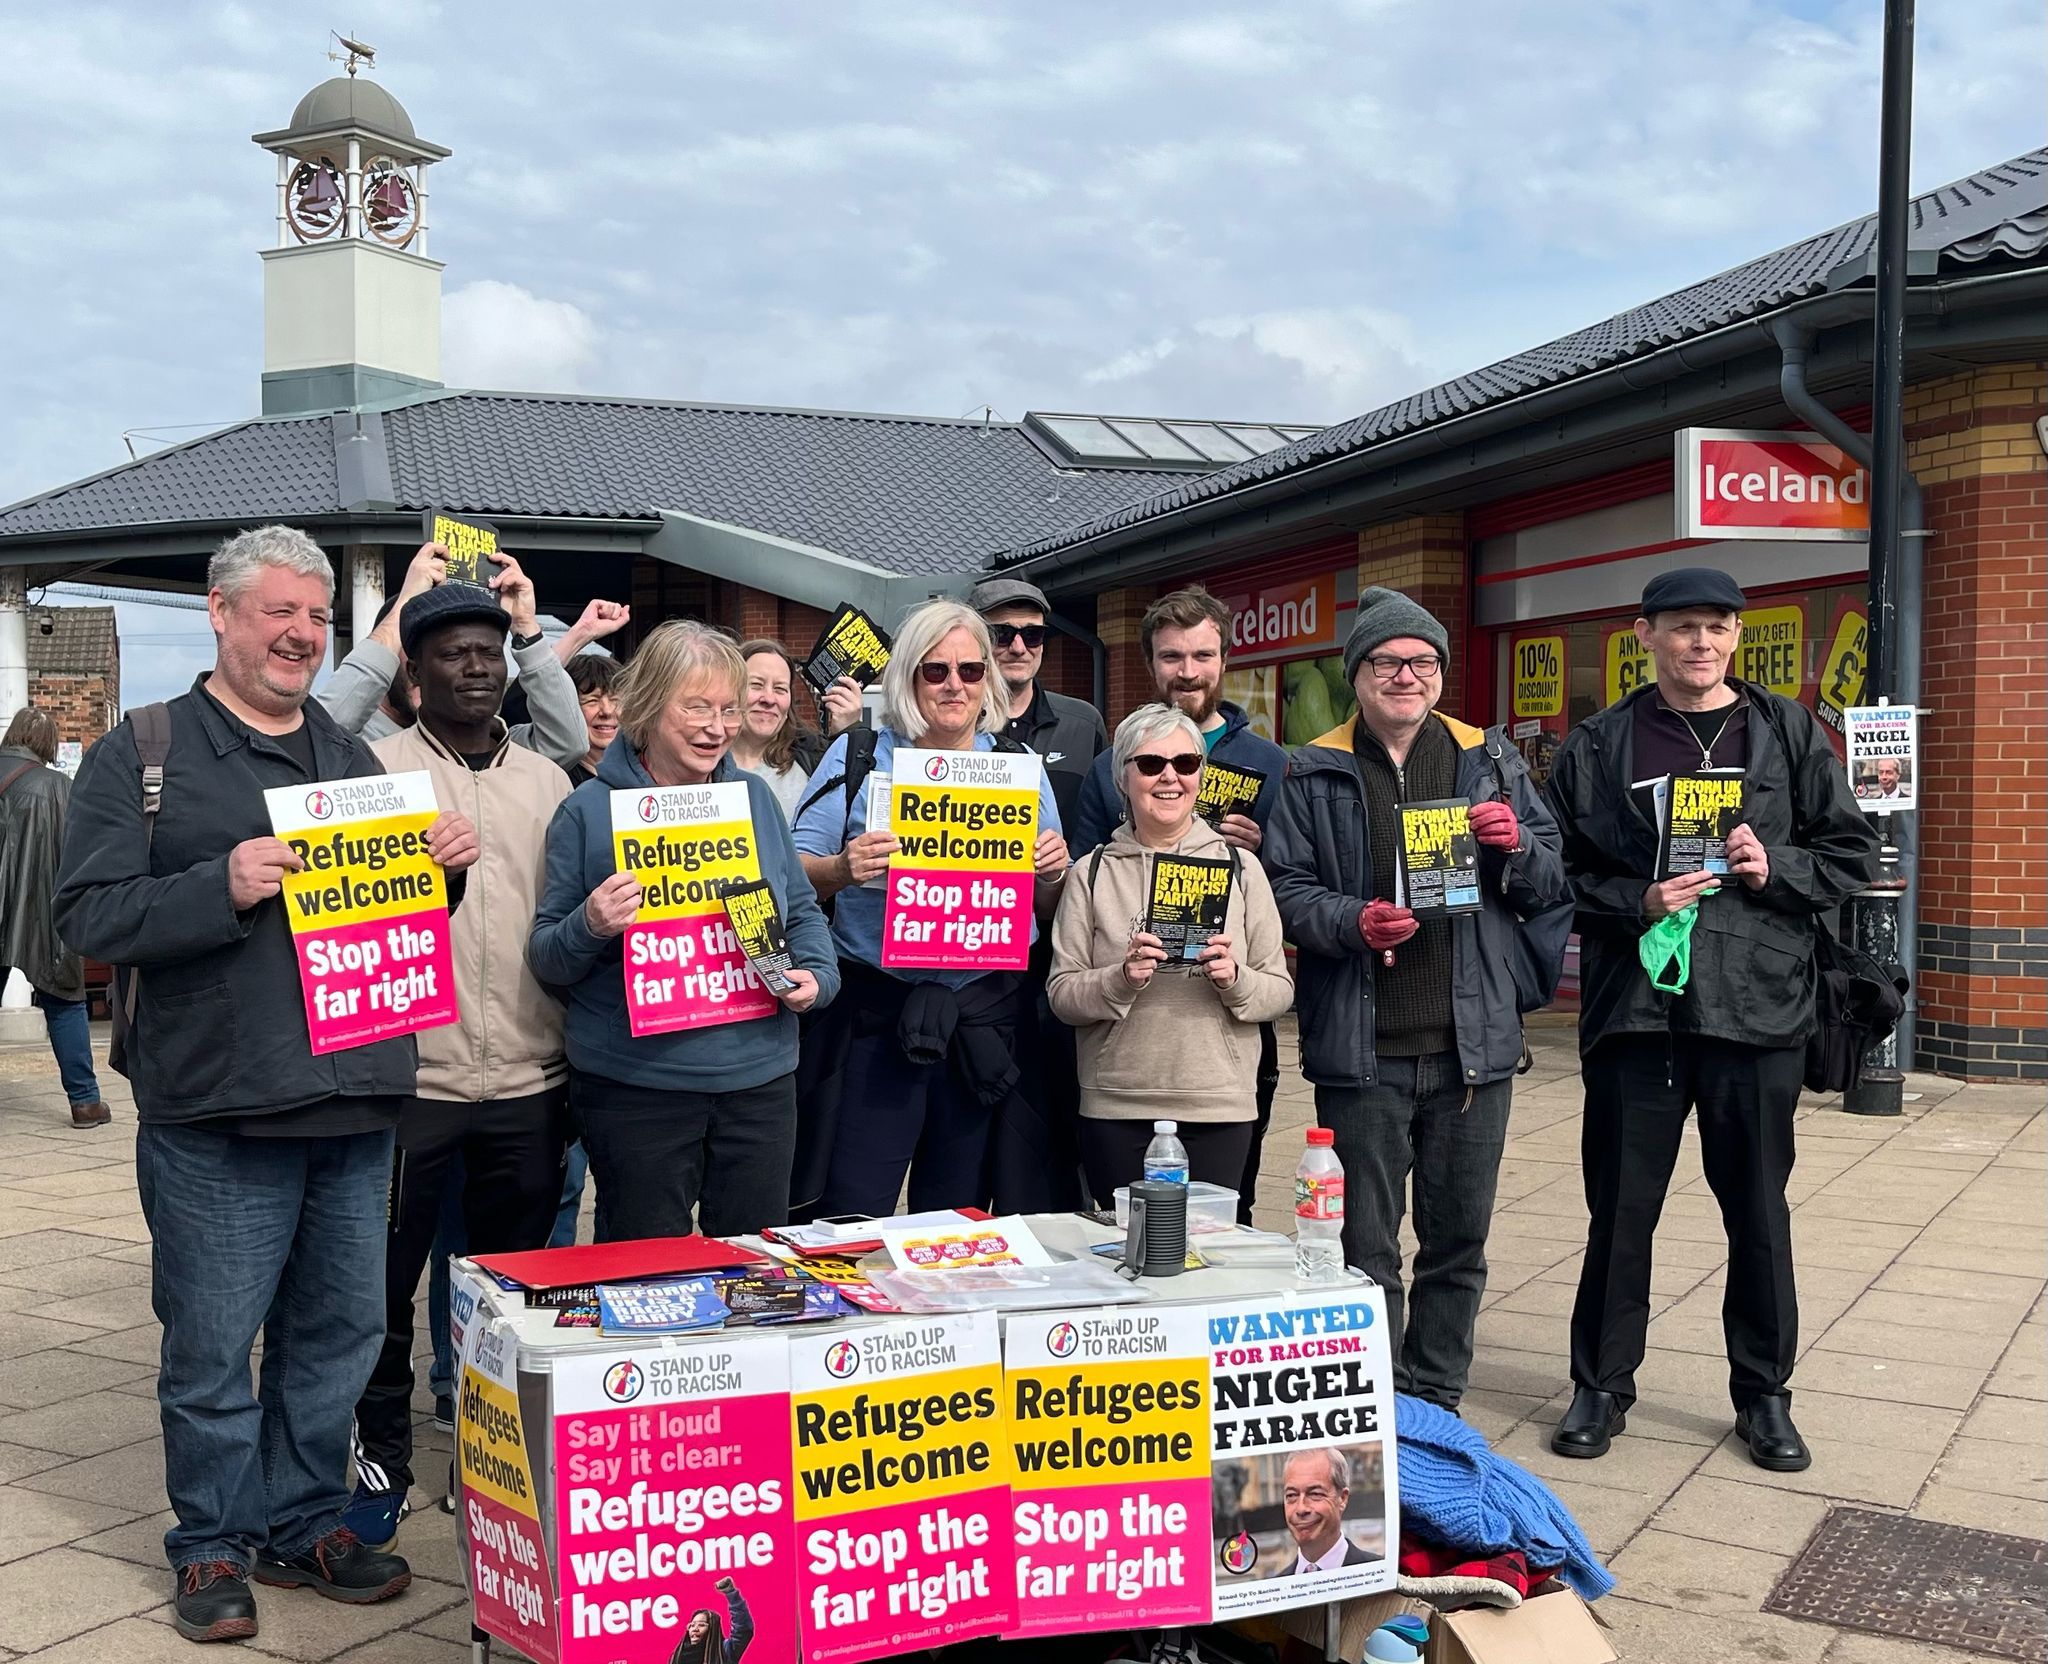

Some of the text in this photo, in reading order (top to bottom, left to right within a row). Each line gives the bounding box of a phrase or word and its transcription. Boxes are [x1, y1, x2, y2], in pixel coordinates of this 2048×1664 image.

[1705, 464, 1864, 504] Iceland
[434, 530, 497, 556] IS A RACIST
[435, 517, 496, 544] REFORM UK
[449, 546, 472, 562] RTY
[1232, 586, 1317, 647] celand
[1743, 622, 1796, 644] BUY 2 GET 1
[1619, 635, 1639, 658] ANY
[1520, 643, 1557, 678] 10%
[1743, 643, 1794, 686] FREE
[1518, 681, 1558, 699] DISCOUNT
[1522, 702, 1530, 712] FOR
[1531, 702, 1543, 712] OVER
[1818, 701, 1839, 727] SAVE
[1850, 711, 1911, 722] WANTED
[1854, 730, 1910, 743] NIGEL
[1854, 745, 1910, 756] FARAGE
[952, 757, 1007, 771] STAND UP
[952, 770, 1012, 784] TO RACISM
[333, 782, 394, 802] STAND UP
[1207, 780, 1259, 802] A RACIST
[1243, 776, 1262, 792] UK
[1674, 780, 1743, 795] REFORM UK
[337, 796, 406, 818] TO RACISM
[661, 791, 712, 808] STAND UP
[900, 792, 1032, 830] Refugees
[1198, 790, 1227, 806] ARTY
[1673, 794, 1742, 808] IS A RACIST
[663, 805, 720, 821] TO RACISM
[1403, 806, 1469, 826] REFORM UK
[1672, 807, 1712, 820] PARTY
[1404, 820, 1470, 840] IS A RACIST
[288, 828, 430, 874] Refugees
[622, 835, 750, 872] Refugees
[899, 830, 1024, 860] welcome
[1406, 836, 1445, 854] PARTY
[1157, 862, 1230, 882] REFORM UK
[295, 871, 433, 917] welcome
[895, 876, 1017, 914] Stop the
[1153, 889, 1197, 907] PARTY
[1155, 876, 1229, 896] IS A RACIST
[726, 888, 773, 913] REFORM UK
[746, 902, 776, 924] RACIST
[736, 921, 762, 941] PARTY
[892, 912, 1012, 951] far right
[305, 924, 436, 977] Stop the
[630, 931, 696, 967] Stop
[702, 922, 743, 955] th
[313, 964, 438, 1021] far right
[633, 973, 675, 1005] far
[684, 961, 760, 1003] right
[603, 1282, 705, 1298] REFORM
[607, 1294, 697, 1307] UK IS A
[612, 1302, 697, 1316] RACIST
[617, 1310, 694, 1323] PARTY
[1083, 1317, 1159, 1338] STAND UP
[1208, 1302, 1375, 1346] WANTED
[863, 1327, 945, 1355] STAND UP
[1083, 1335, 1167, 1357] TO RACISM
[1215, 1337, 1367, 1367] FOR RACISM.
[650, 1354, 732, 1377] STAND UP
[864, 1345, 956, 1375] TO RACISM
[652, 1372, 742, 1397] TO RACISM
[1213, 1360, 1374, 1412] NIGEL
[463, 1376, 520, 1447] Refugees
[1016, 1375, 1200, 1424] Refugees
[568, 1406, 721, 1452] Say it loud
[796, 1387, 995, 1448] Refugees
[1214, 1405, 1378, 1450] FARAGE
[1014, 1427, 1192, 1473] welcome
[463, 1437, 527, 1499] welcome
[568, 1443, 742, 1486] Say it clear:
[801, 1441, 990, 1501] welcome
[569, 1480, 783, 1536] Refugees
[468, 1498, 539, 1571] Stop the
[1014, 1494, 1187, 1551] Stop the
[807, 1508, 989, 1576] Stop the
[570, 1531, 774, 1587] welcome
[1016, 1546, 1185, 1601] far right
[475, 1550, 546, 1627] far right
[811, 1557, 990, 1631] far right
[572, 1593, 679, 1639] here
